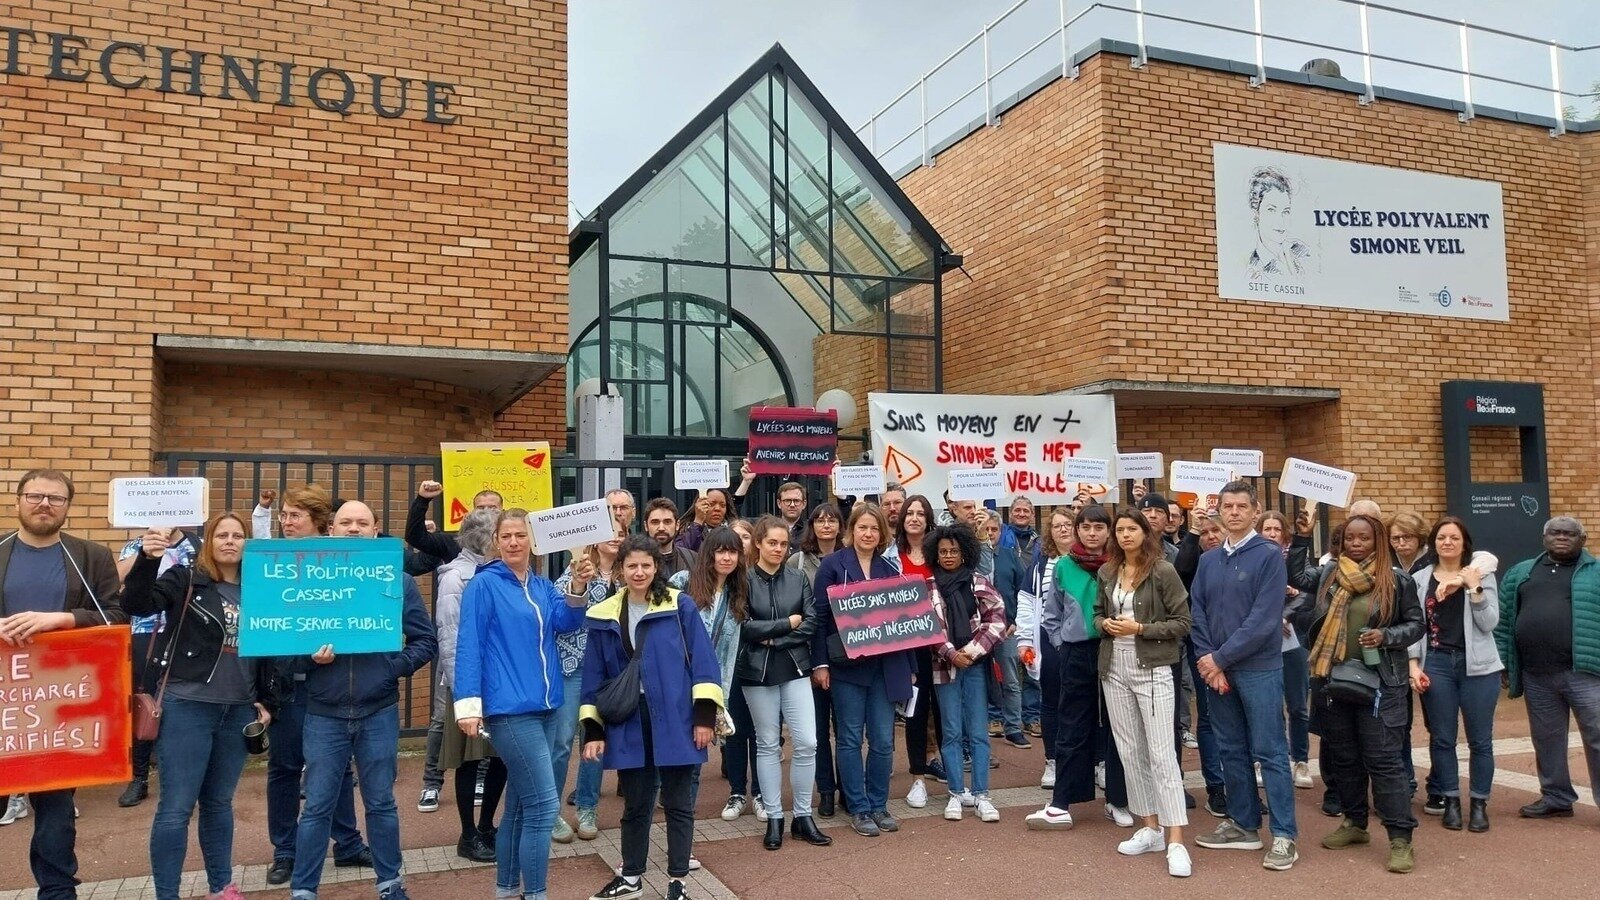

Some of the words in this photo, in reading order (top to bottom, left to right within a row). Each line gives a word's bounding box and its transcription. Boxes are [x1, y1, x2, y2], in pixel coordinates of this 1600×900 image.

[0, 26, 459, 126] TECHNIQUE
[1314, 206, 1373, 228] LYCÉE
[1377, 212, 1490, 229] POLYVALENT
[1350, 238, 1421, 255] SIMONE
[1423, 239, 1465, 255] VEIL
[1248, 282, 1269, 293] SITE
[1274, 284, 1305, 295] CASSIN
[1476, 395, 1498, 406] Région
[756, 420, 784, 432] LYCÉES
[786, 424, 804, 434] SANS
[806, 426, 833, 434] MOYENS
[884, 408, 926, 432] SANS
[937, 414, 998, 437] MOYENS
[1014, 413, 1042, 434] EN
[1053, 410, 1080, 433] +
[936, 440, 995, 464] SIMONE
[1004, 442, 1026, 462] SE
[1043, 442, 1081, 462] MET
[453, 465, 474, 478] DES
[1306, 466, 1330, 477] MOYENS
[1331, 472, 1348, 480] POUR
[1006, 470, 1066, 493] VEILLE
[1492, 494, 1512, 502] régional
[572, 505, 599, 516] CLASSES
[549, 524, 597, 539] SURCHARGÉES
[264, 563, 298, 580] LES
[306, 562, 395, 582] POLITIQUES
[282, 587, 356, 602] CASSENT
[838, 592, 866, 611] LYCÉES
[868, 593, 886, 608] SANS
[888, 587, 919, 603] MOYENS
[250, 616, 293, 632] NOTRE
[296, 617, 344, 632] SERVICE
[347, 614, 394, 631] PUBLIC
[847, 625, 881, 644] AVENIRS
